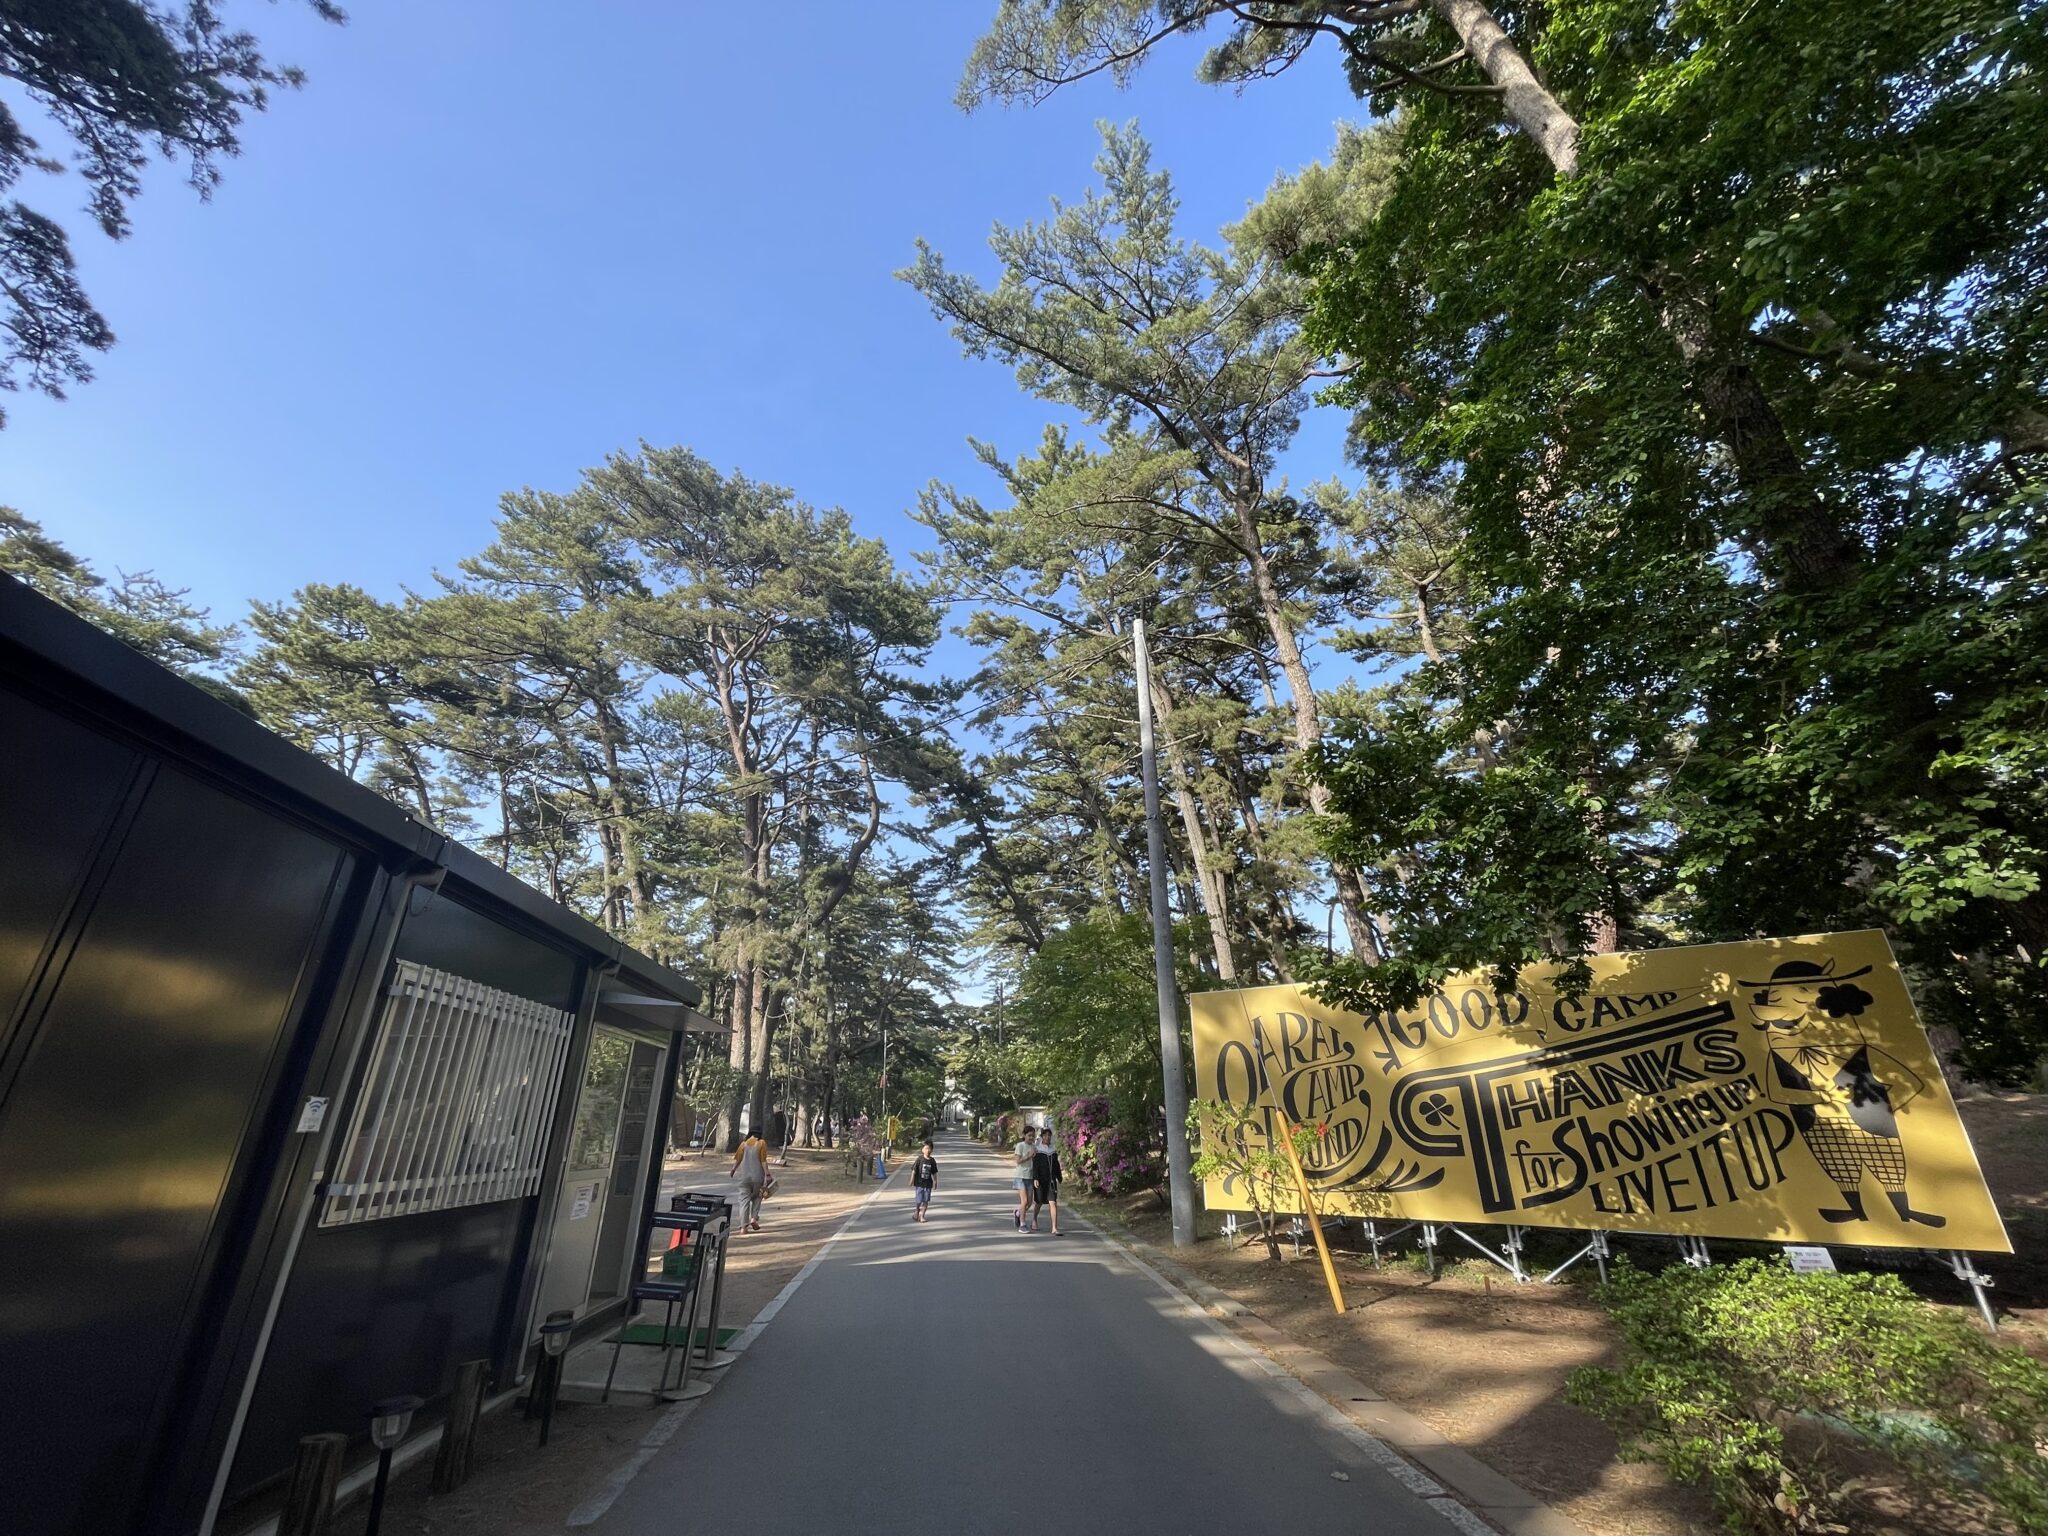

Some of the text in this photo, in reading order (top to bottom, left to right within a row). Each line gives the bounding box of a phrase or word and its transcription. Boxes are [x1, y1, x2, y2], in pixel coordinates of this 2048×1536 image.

[1388, 988, 1678, 1050] GOOD CAMP
[1215, 1012, 1354, 1116] OARAI
[1283, 1063, 1367, 1124] CAMP
[1234, 1106, 1363, 1169] GRUND
[1390, 1000, 1747, 1214] THANKS
[1511, 1139, 1567, 1194] for
[1521, 1096, 1728, 1210] Showing
